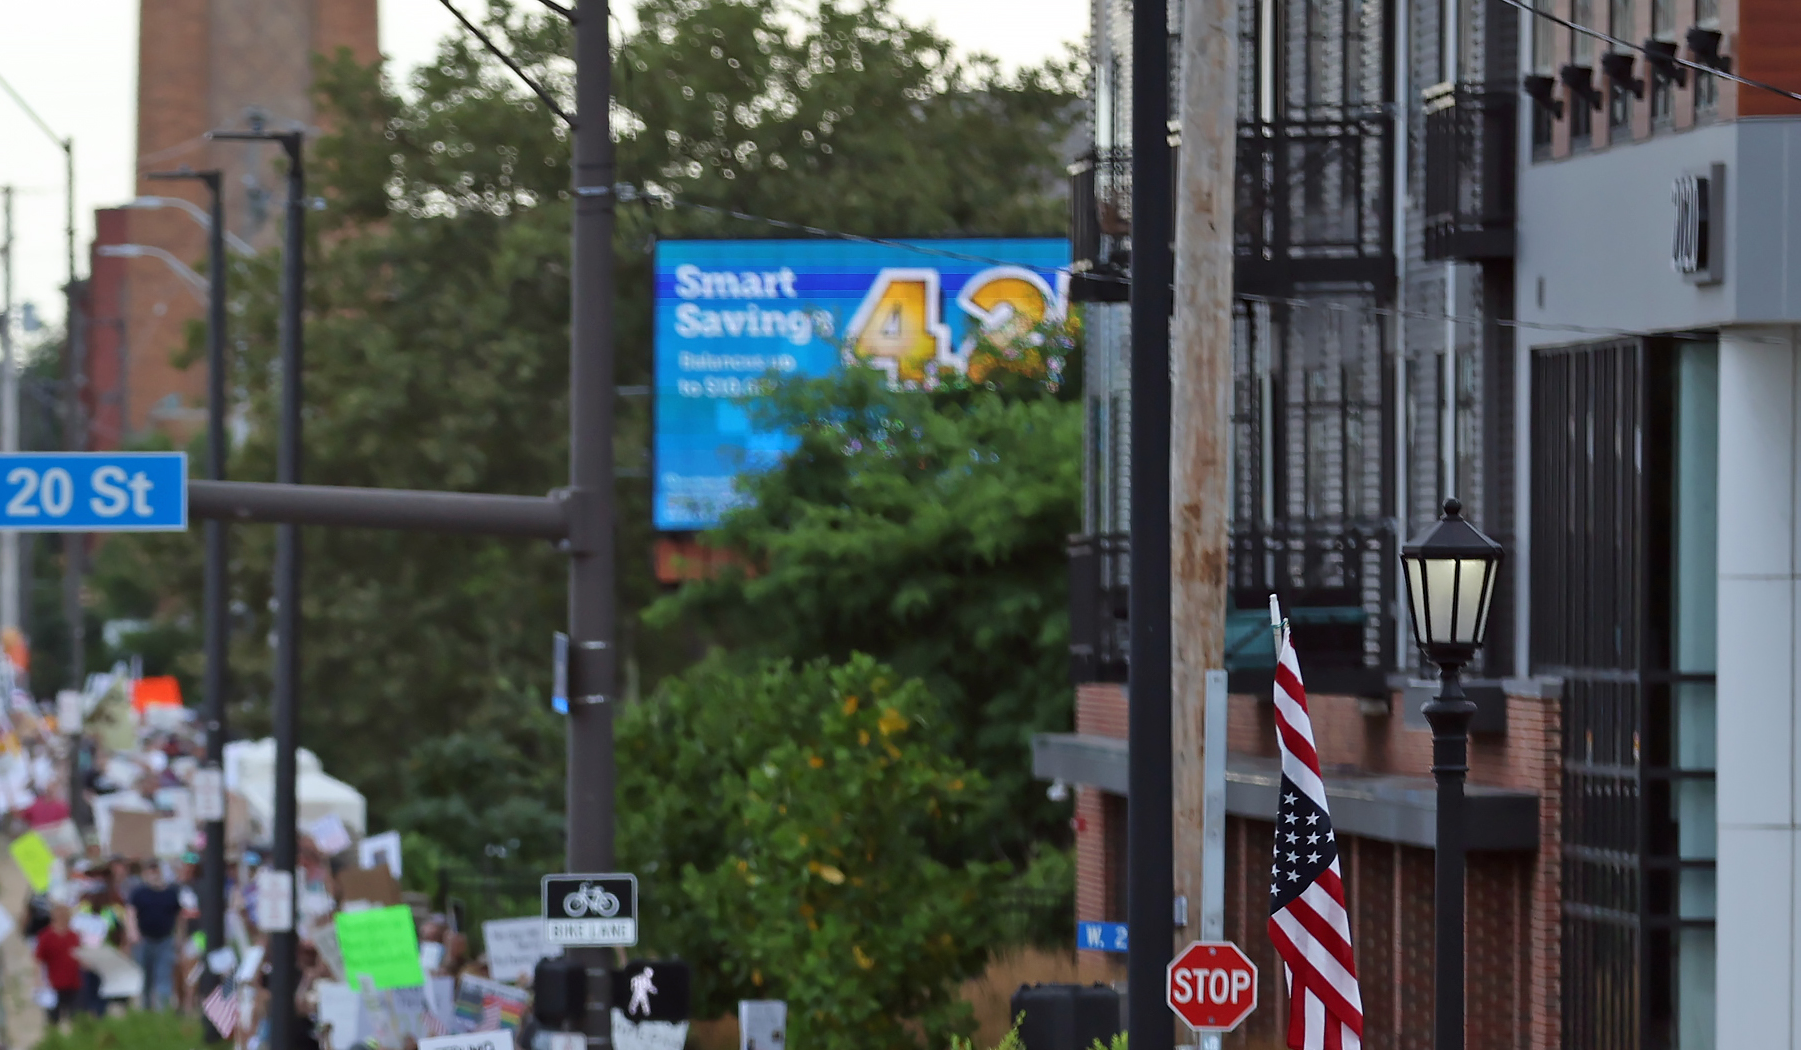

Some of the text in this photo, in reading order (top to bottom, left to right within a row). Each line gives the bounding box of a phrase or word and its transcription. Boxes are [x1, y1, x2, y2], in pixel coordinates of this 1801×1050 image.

[675, 264, 797, 299] Smart
[6, 466, 74, 517] 20
[90, 466, 154, 517] St
[554, 925, 627, 938] BIKE LANE
[1086, 925, 1129, 948] W. 2
[1172, 968, 1251, 1004] STOP
